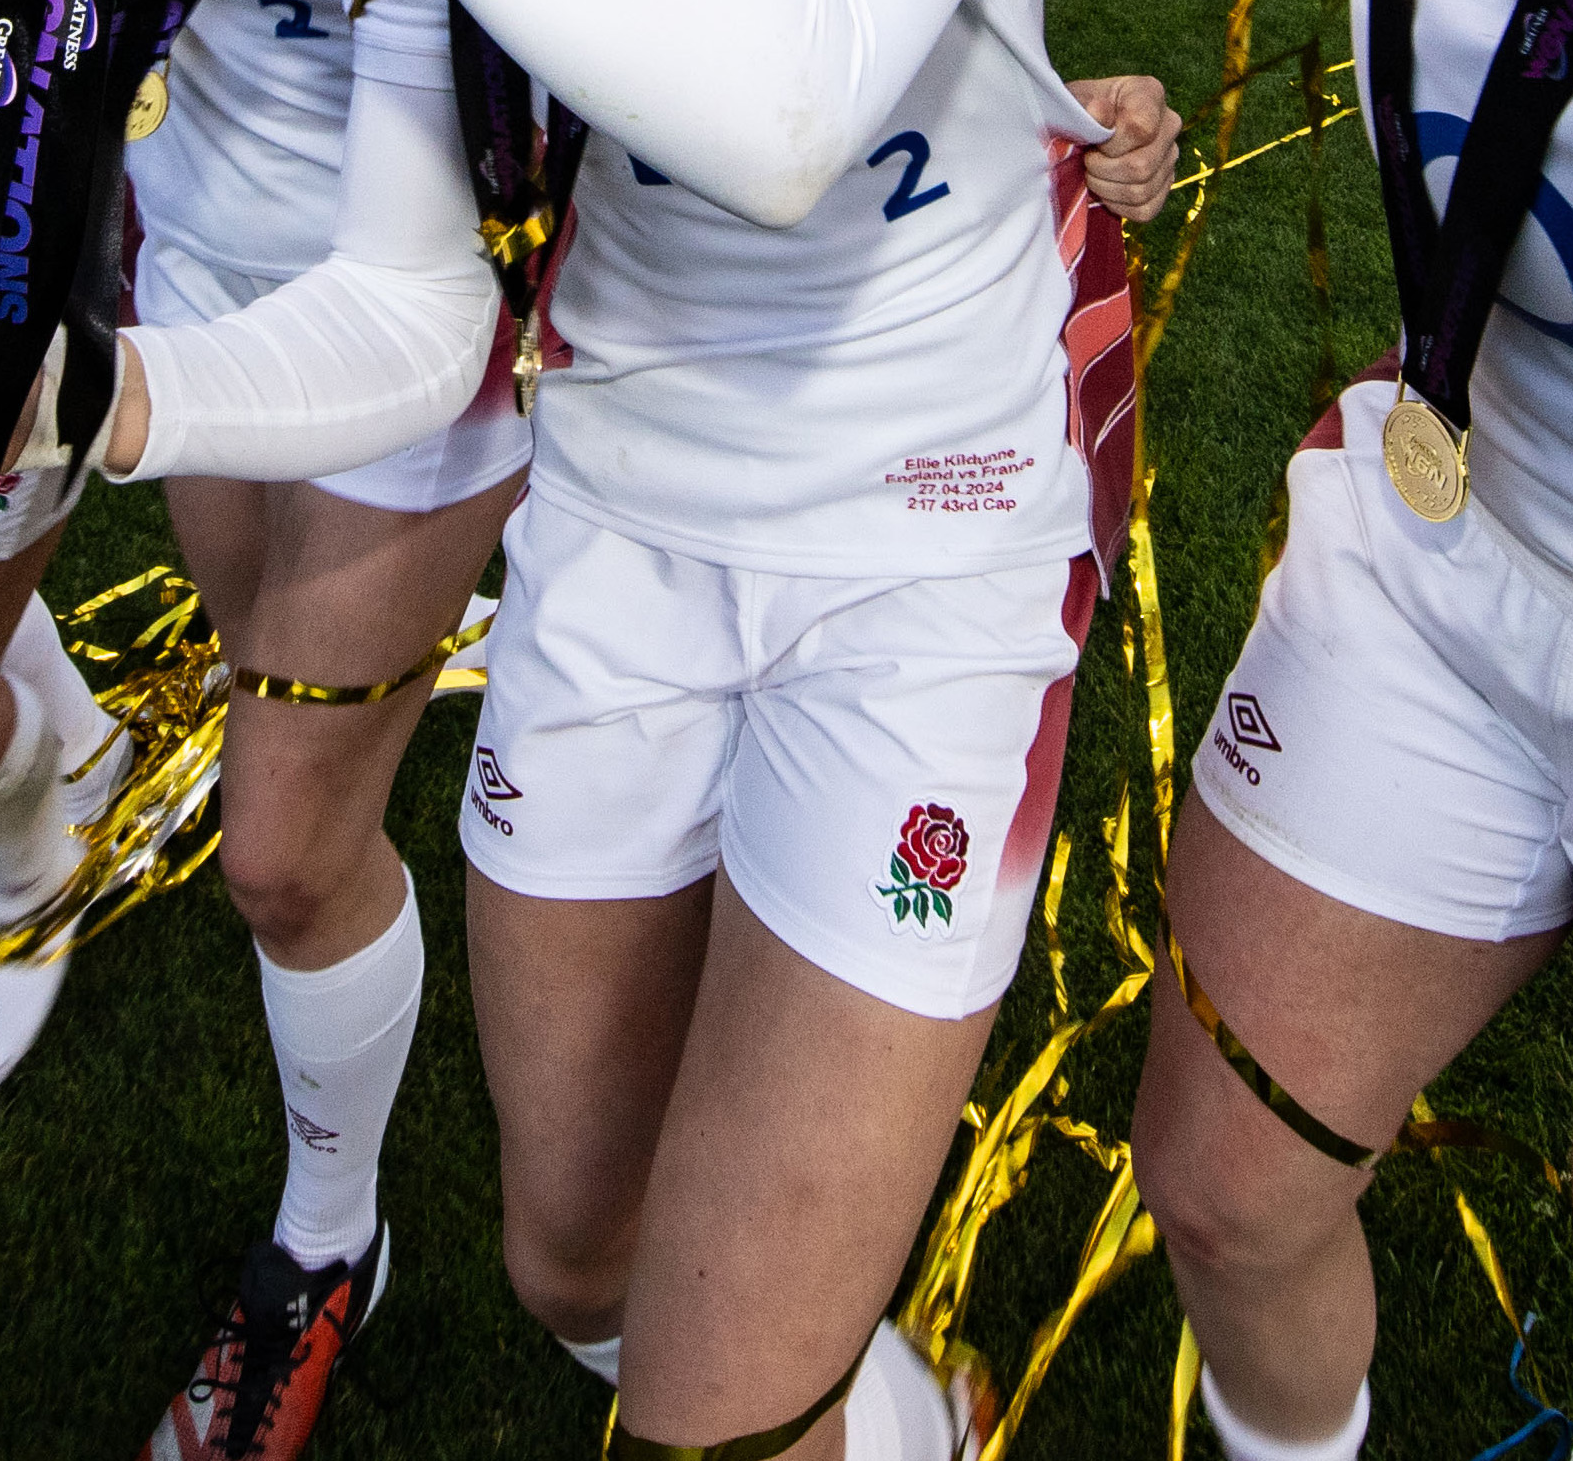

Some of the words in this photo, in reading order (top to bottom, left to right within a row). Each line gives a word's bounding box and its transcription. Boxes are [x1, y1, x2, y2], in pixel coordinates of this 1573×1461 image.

[885, 470, 954, 485] England
[958, 470, 977, 480] vs
[982, 457, 1035, 478] France
[905, 457, 940, 471] Ellie
[944, 449, 1016, 468] Kildunne
[918, 480, 1005, 496] 27.04.2024
[907, 497, 936, 512] 217
[940, 498, 978, 512] 43rd
[983, 497, 1017, 513] Cap
[1213, 726, 1261, 787] umbro
[470, 784, 514, 837] umbro
